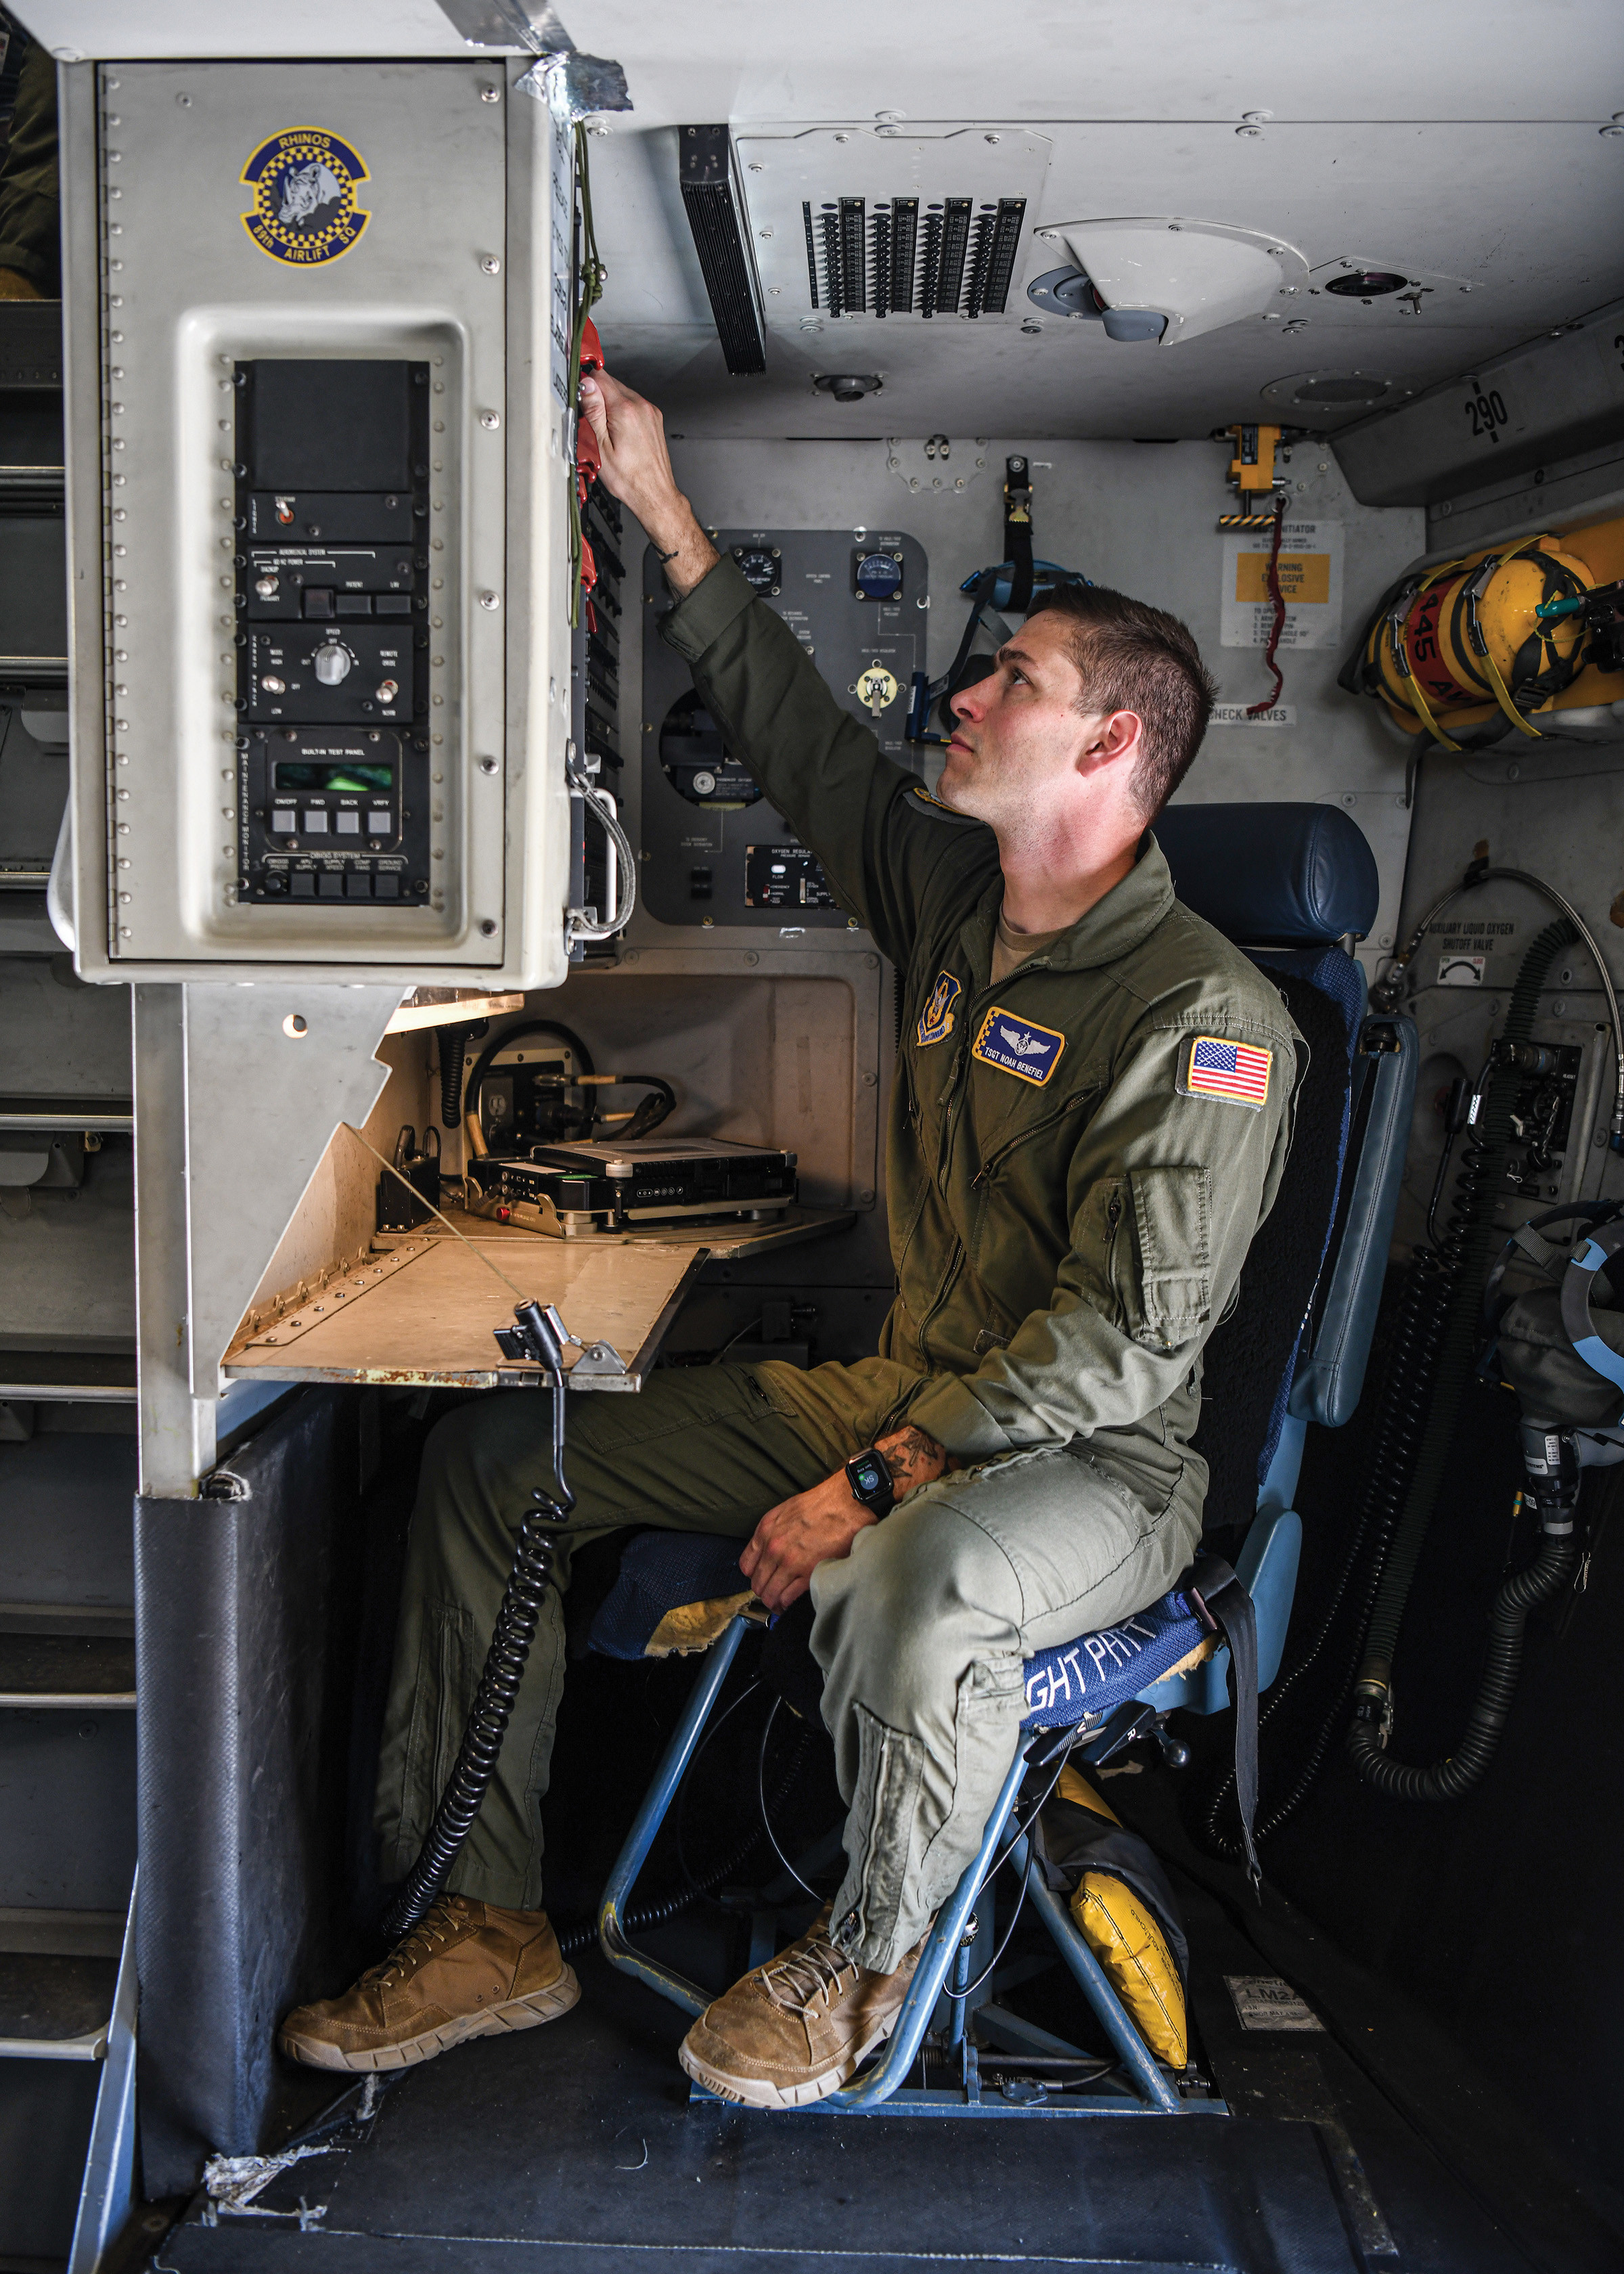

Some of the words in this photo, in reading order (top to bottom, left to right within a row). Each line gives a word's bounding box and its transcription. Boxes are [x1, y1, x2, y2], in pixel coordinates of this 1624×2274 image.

[279, 133, 331, 148] RHINOS
[253, 225, 273, 248] 89th
[284, 246, 330, 261] AIRLIFT
[339, 227, 357, 244] SQ
[1464, 390, 1508, 436] 290
[1282, 525, 1316, 533] NITIATOR
[1265, 563, 1303, 572] WRNING
[1261, 574, 1305, 583] ELOSIVE
[1269, 585, 1297, 594] VICE
[1414, 594, 1439, 662] 445
[241, 753, 250, 824] MAINTENANCE
[242, 826, 250, 871] MONITOR
[1428, 922, 1462, 934] AUXILIARY
[1463, 922, 1485, 935] LIQUID
[1487, 922, 1514, 935] OXYGEN
[1443, 938, 1471, 950] SHUTOFF
[1473, 939, 1493, 951] VALVE
[985, 1047, 1000, 1061] TSGT
[999, 1054, 1017, 1068] NOAH
[1016, 1061, 1043, 1079] BENEFIEL
